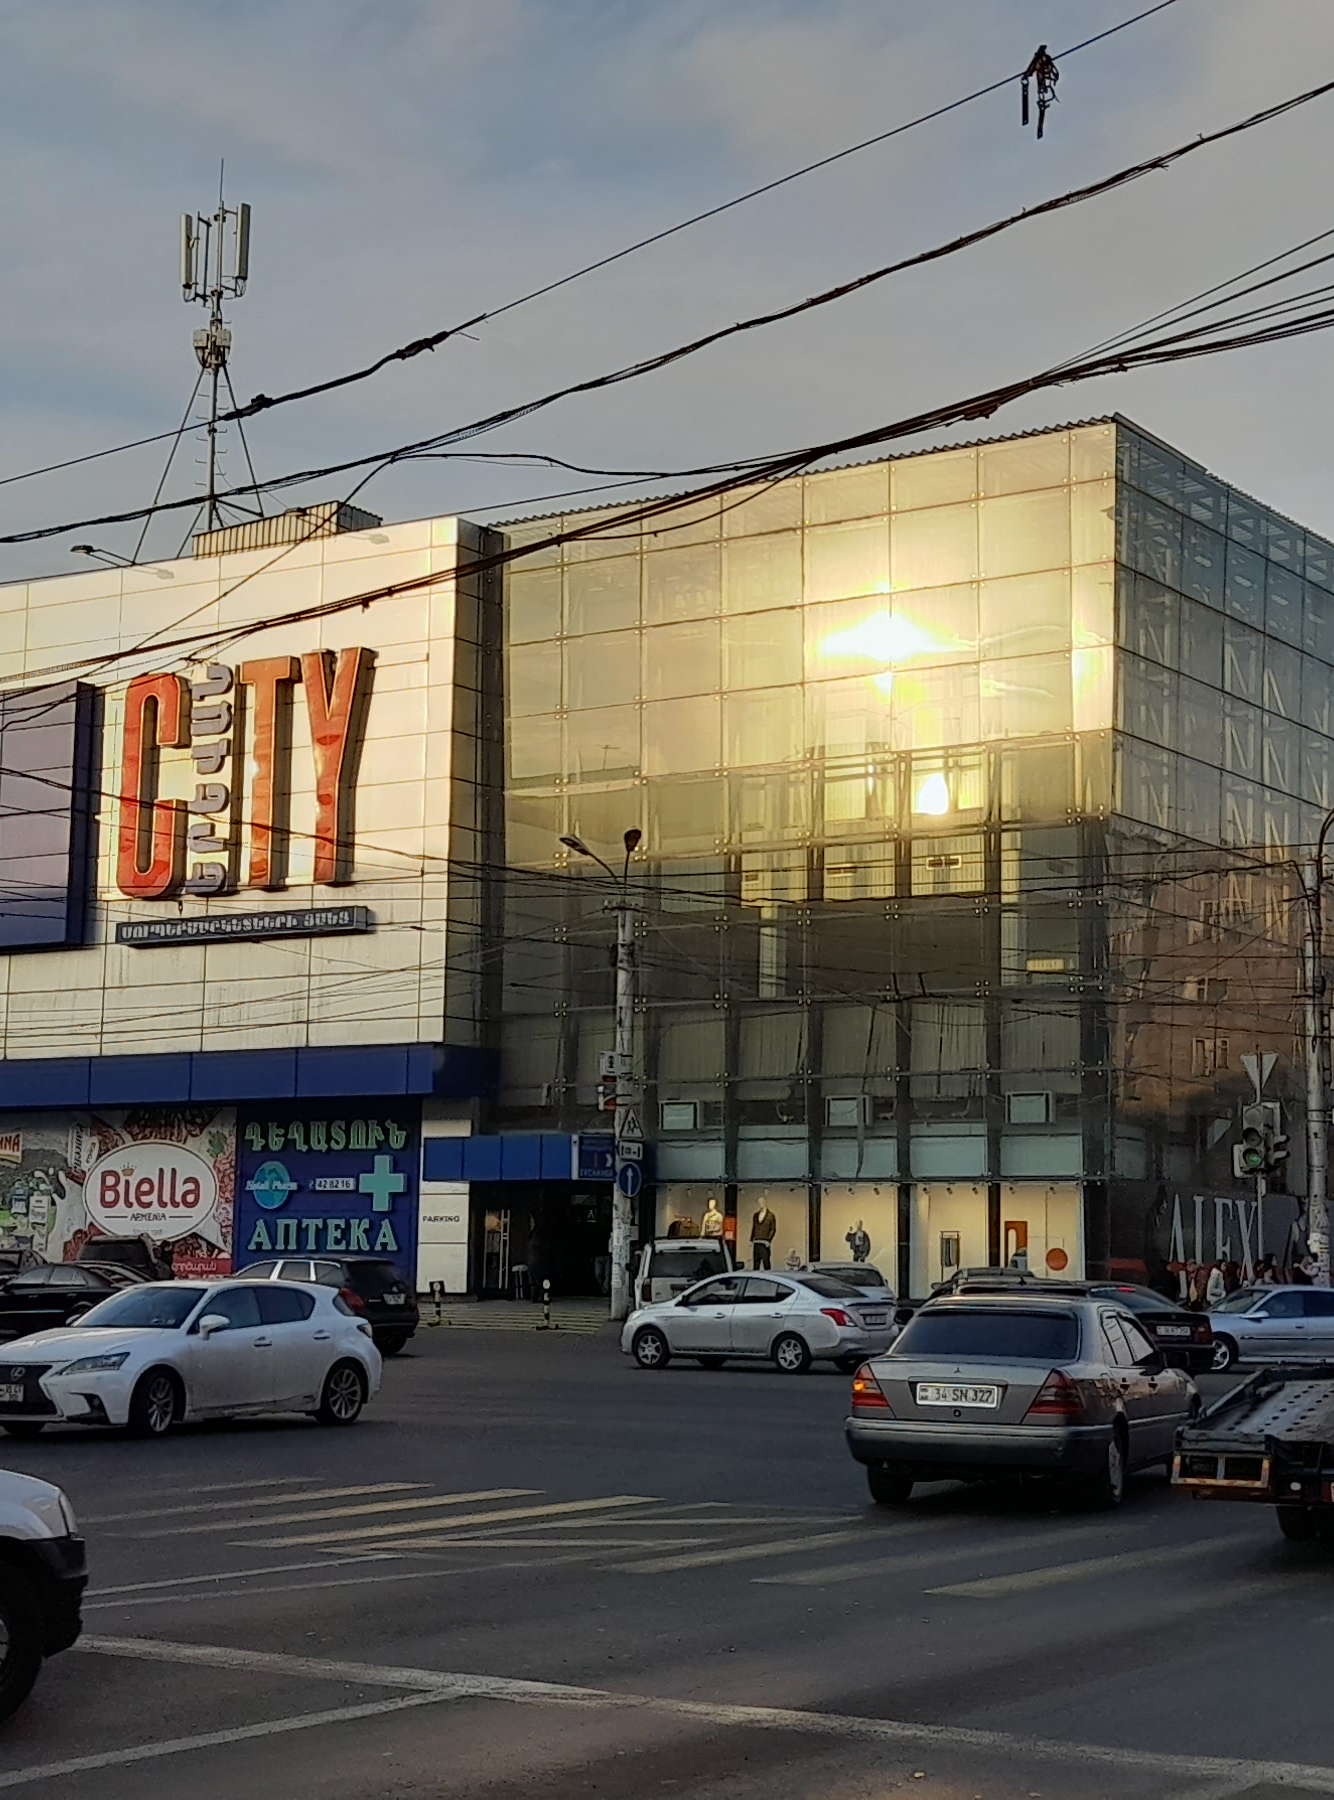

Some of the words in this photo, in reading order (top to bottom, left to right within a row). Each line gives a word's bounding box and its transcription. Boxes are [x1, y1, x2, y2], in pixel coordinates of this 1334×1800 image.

[244, 1118, 407, 1152] ԴԵՂԱՏՈՒՆ
[100, 1168, 200, 1209] Biella
[247, 1217, 399, 1252] АПТЕКА
[423, 1215, 460, 1223] PARKING
